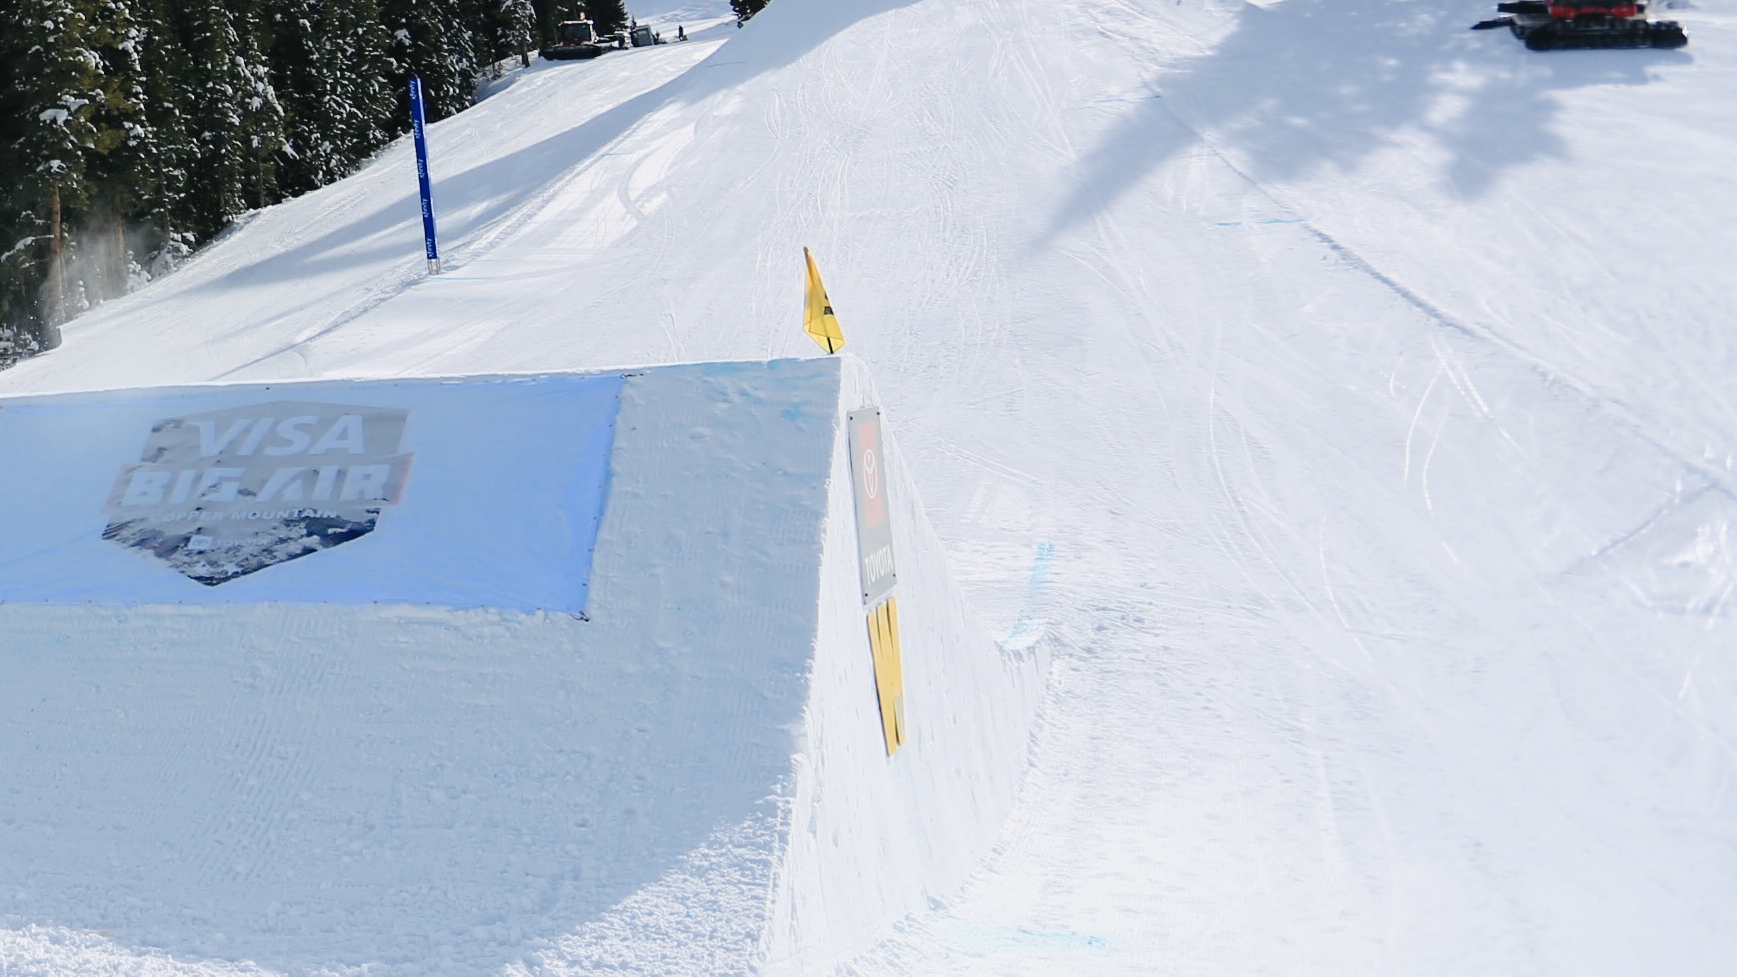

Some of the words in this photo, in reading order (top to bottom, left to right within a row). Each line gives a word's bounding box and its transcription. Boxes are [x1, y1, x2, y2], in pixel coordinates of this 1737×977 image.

[193, 414, 364, 456] VISA
[120, 467, 247, 505] BIG
[256, 464, 391, 502] AIR
[231, 509, 338, 520] MOUNTAIN
[864, 544, 894, 586] TOYOTA
